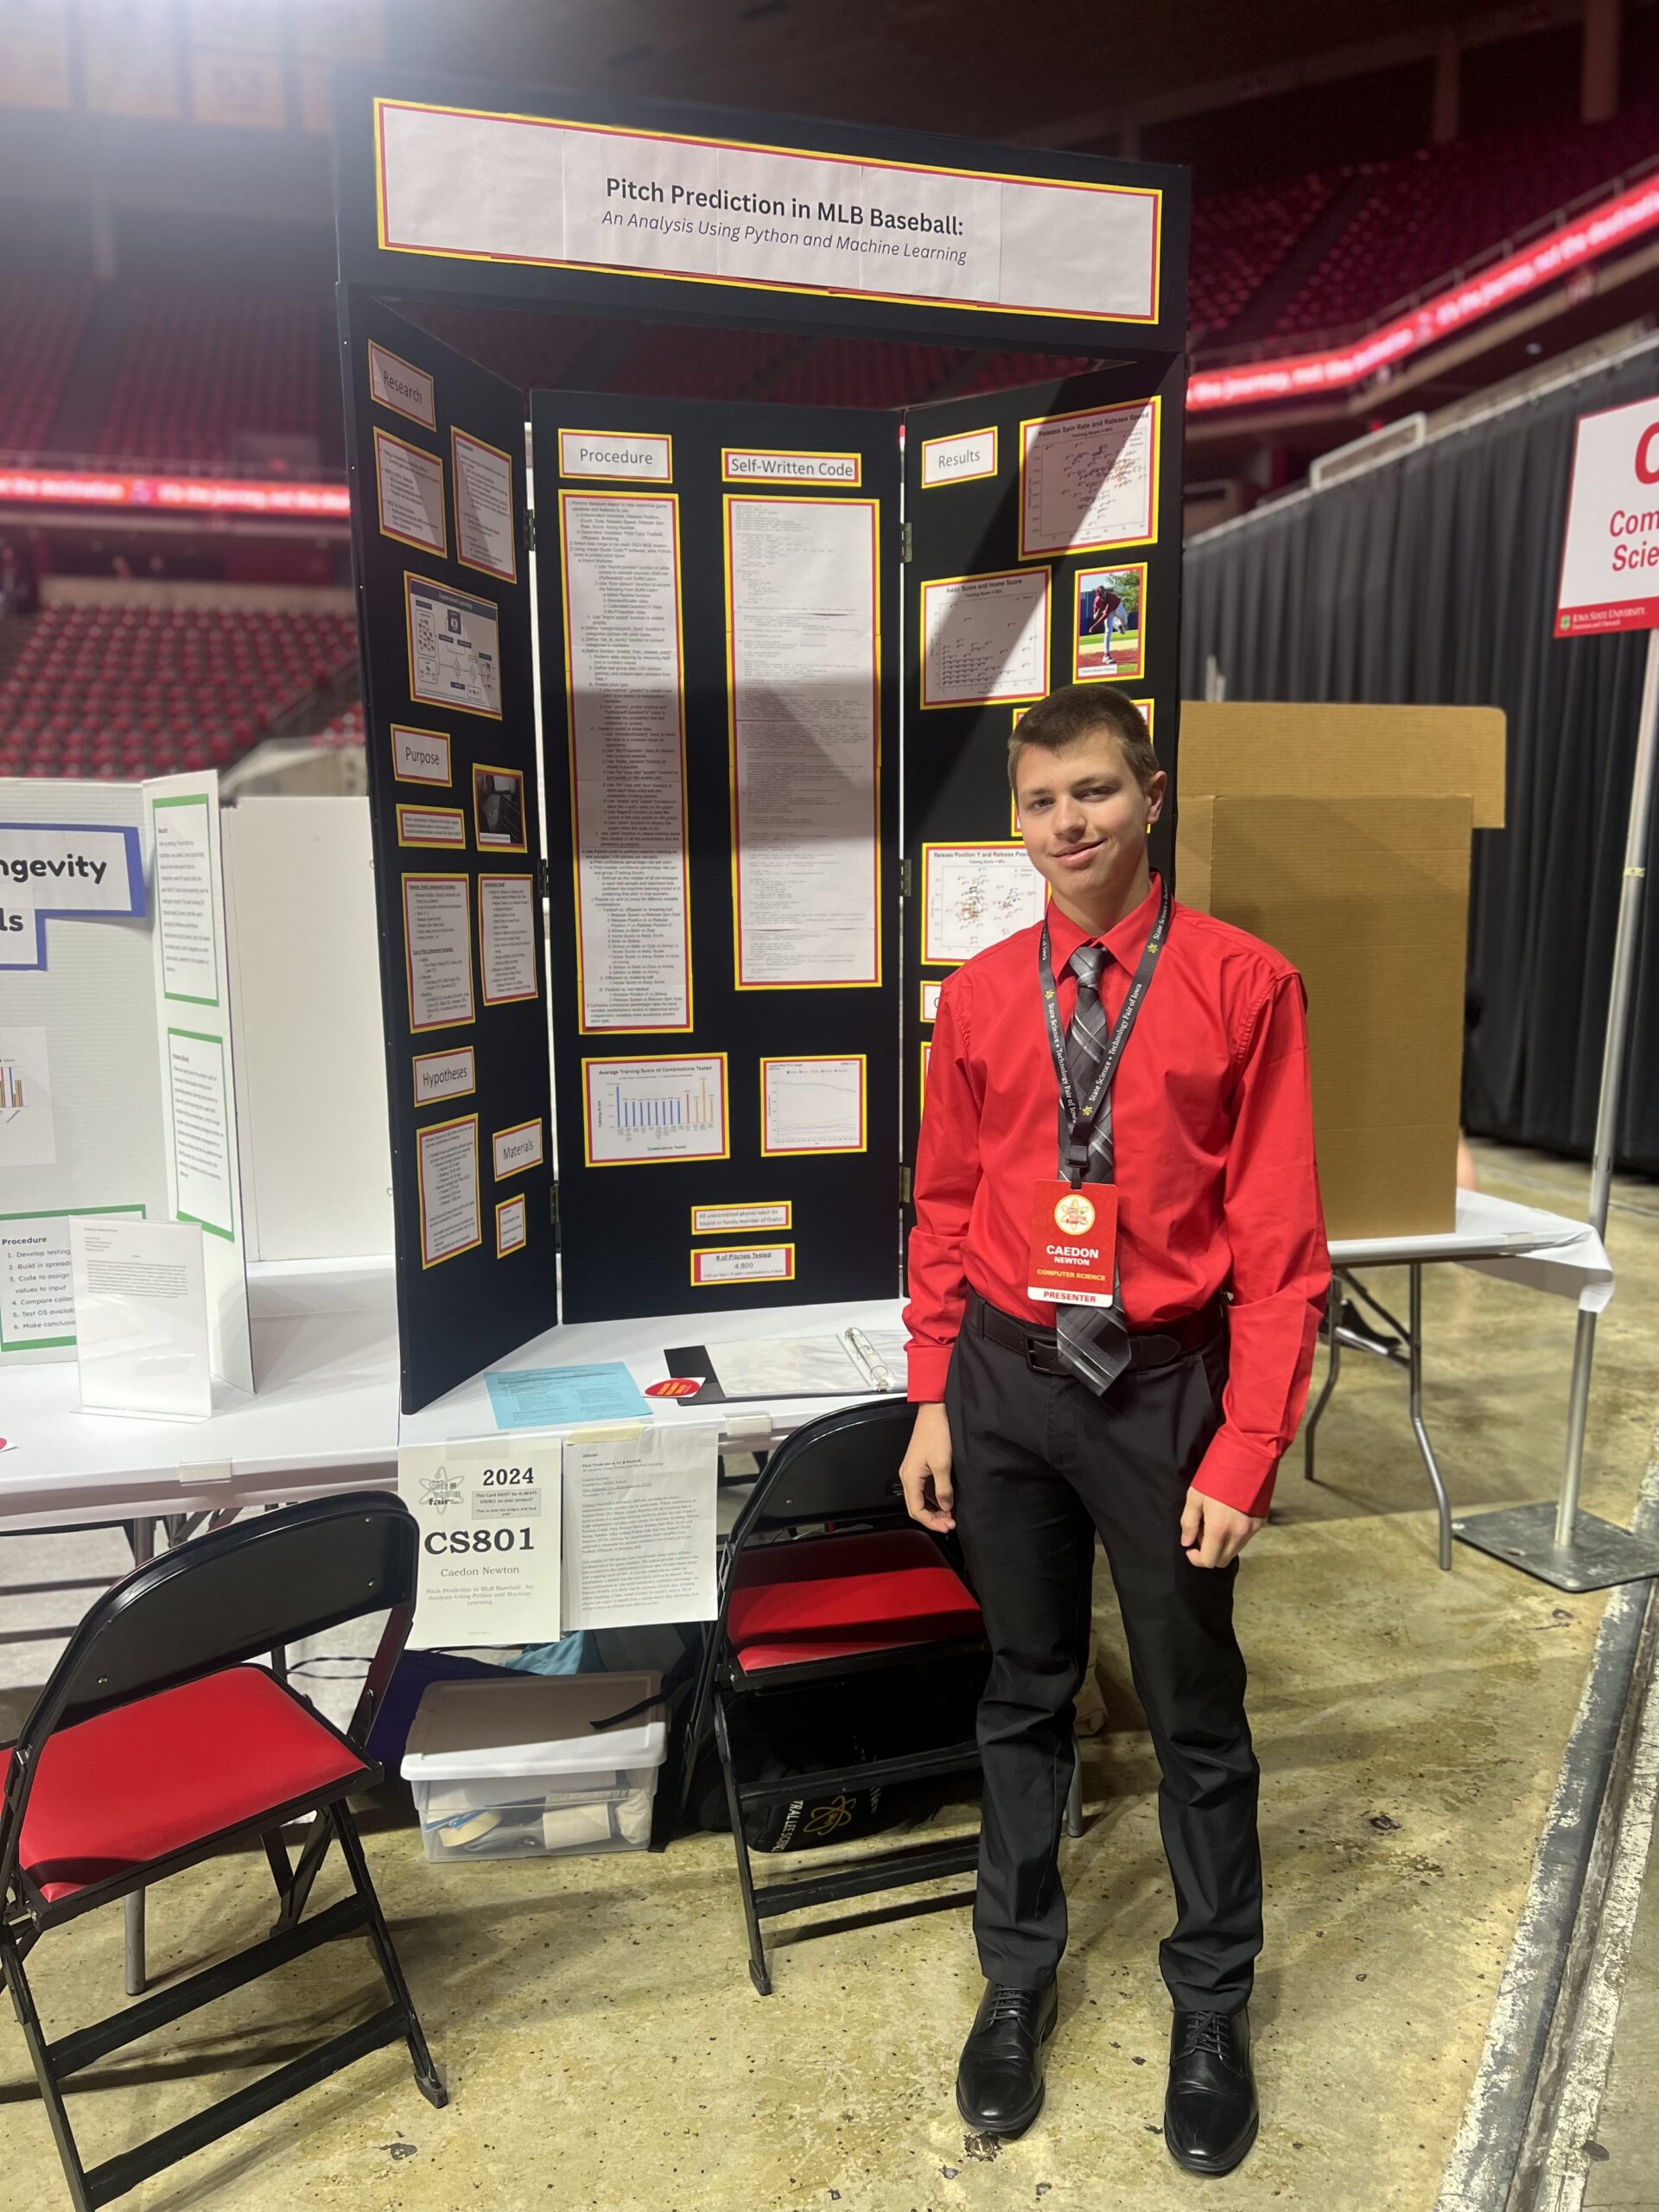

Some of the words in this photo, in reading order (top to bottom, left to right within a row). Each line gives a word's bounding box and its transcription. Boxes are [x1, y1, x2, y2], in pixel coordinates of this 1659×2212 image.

[607, 177, 664, 203] Pitch
[671, 184, 785, 216] Prediction
[791, 198, 810, 219] in
[817, 201, 864, 225] MLB
[870, 207, 963, 235] Baseball:
[601, 211, 623, 226] An
[627, 213, 694, 234] Analysis
[698, 220, 741, 242] Using
[745, 226, 798, 245] Python
[803, 234, 833, 248] and
[836, 236, 899, 256] Machine
[904, 243, 968, 266] Learning
[383, 369, 423, 404] Research
[1039, 427, 1061, 437] Release
[1062, 425, 1076, 434] Spin
[1104, 416, 1128, 425] Release
[1129, 411, 1149, 422] Speed
[580, 448, 653, 464] Procedure
[938, 449, 981, 468] Results
[731, 458, 815, 475] Self-Written
[818, 462, 854, 477] Code
[1610, 510, 1659, 537] Com
[1612, 541, 1659, 571] Scie
[405, 747, 440, 766] Purpose
[1131, 983, 1142, 1001] Iowa
[1128, 997, 1136, 1007] of
[1122, 1006, 1134, 1020] Fair
[1109, 1020, 1128, 1055] Technology
[1051, 1019, 1059, 1044] Science
[1056, 1048, 1069, 1085] Technology
[1067, 1098, 1076, 1108] of
[1096, 1061, 1111, 1085] Science
[423, 1066, 467, 1089] Hypotheses
[1089, 1084, 1101, 1103] State
[503, 1139, 534, 1160] Materials
[1046, 1245, 1099, 1259] CAEDON
[1054, 1256, 1090, 1266] NEWTON
[1037, 1268, 1075, 1279] COMPUTER
[1076, 1272, 1106, 1281] SCIENCE
[1043, 1291, 1096, 1303] PRESENTER
[483, 1467, 534, 1486] 2024
[424, 1527, 534, 1555] CS801
[441, 1567, 479, 1577] Caedon
[482, 1566, 519, 1575] Newton
